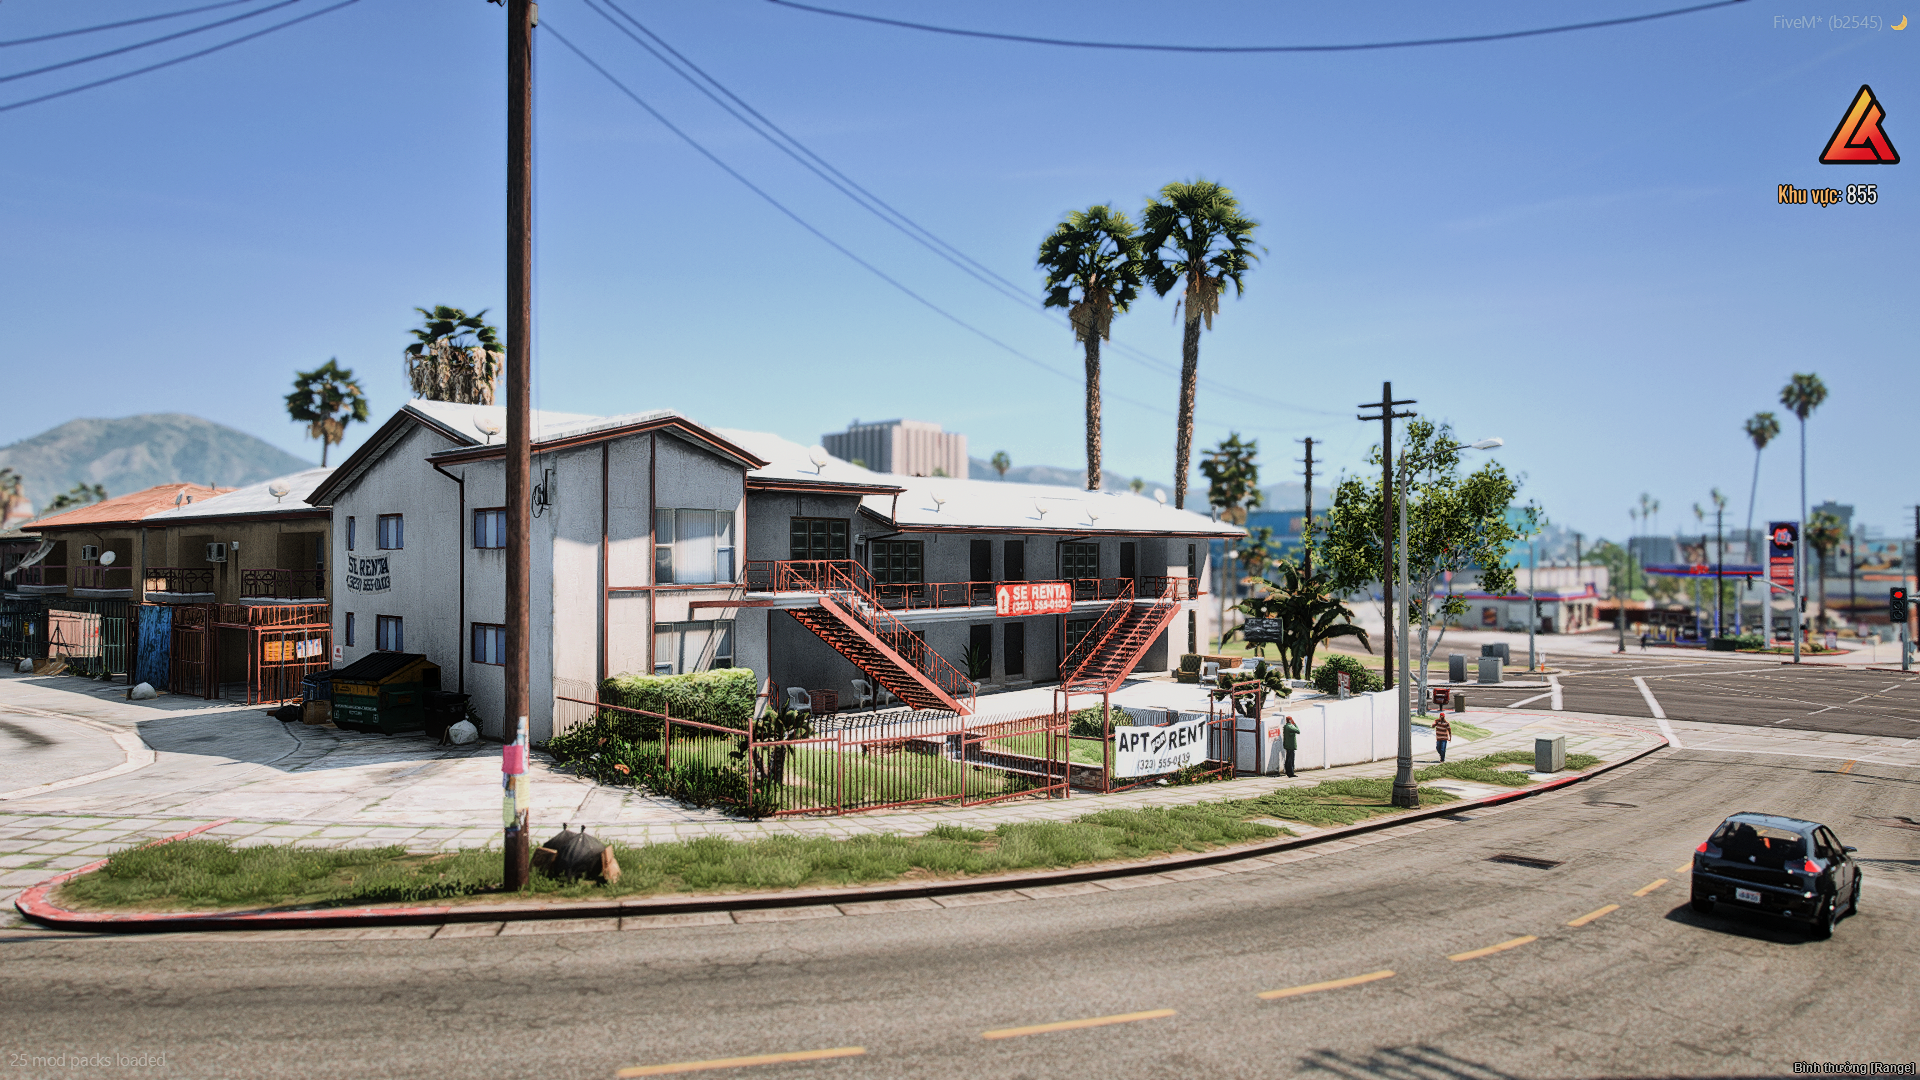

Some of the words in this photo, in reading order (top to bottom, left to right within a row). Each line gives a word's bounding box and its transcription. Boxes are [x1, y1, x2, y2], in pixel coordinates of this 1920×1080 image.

[359, 557, 390, 576] RENTA
[1012, 586, 1028, 601] SE
[1031, 585, 1067, 600] RENTA
[1012, 601, 1033, 614] (323)
[1119, 731, 1151, 753] APT
[1168, 720, 1206, 750] RENT
[1136, 759, 1156, 773] (323)
